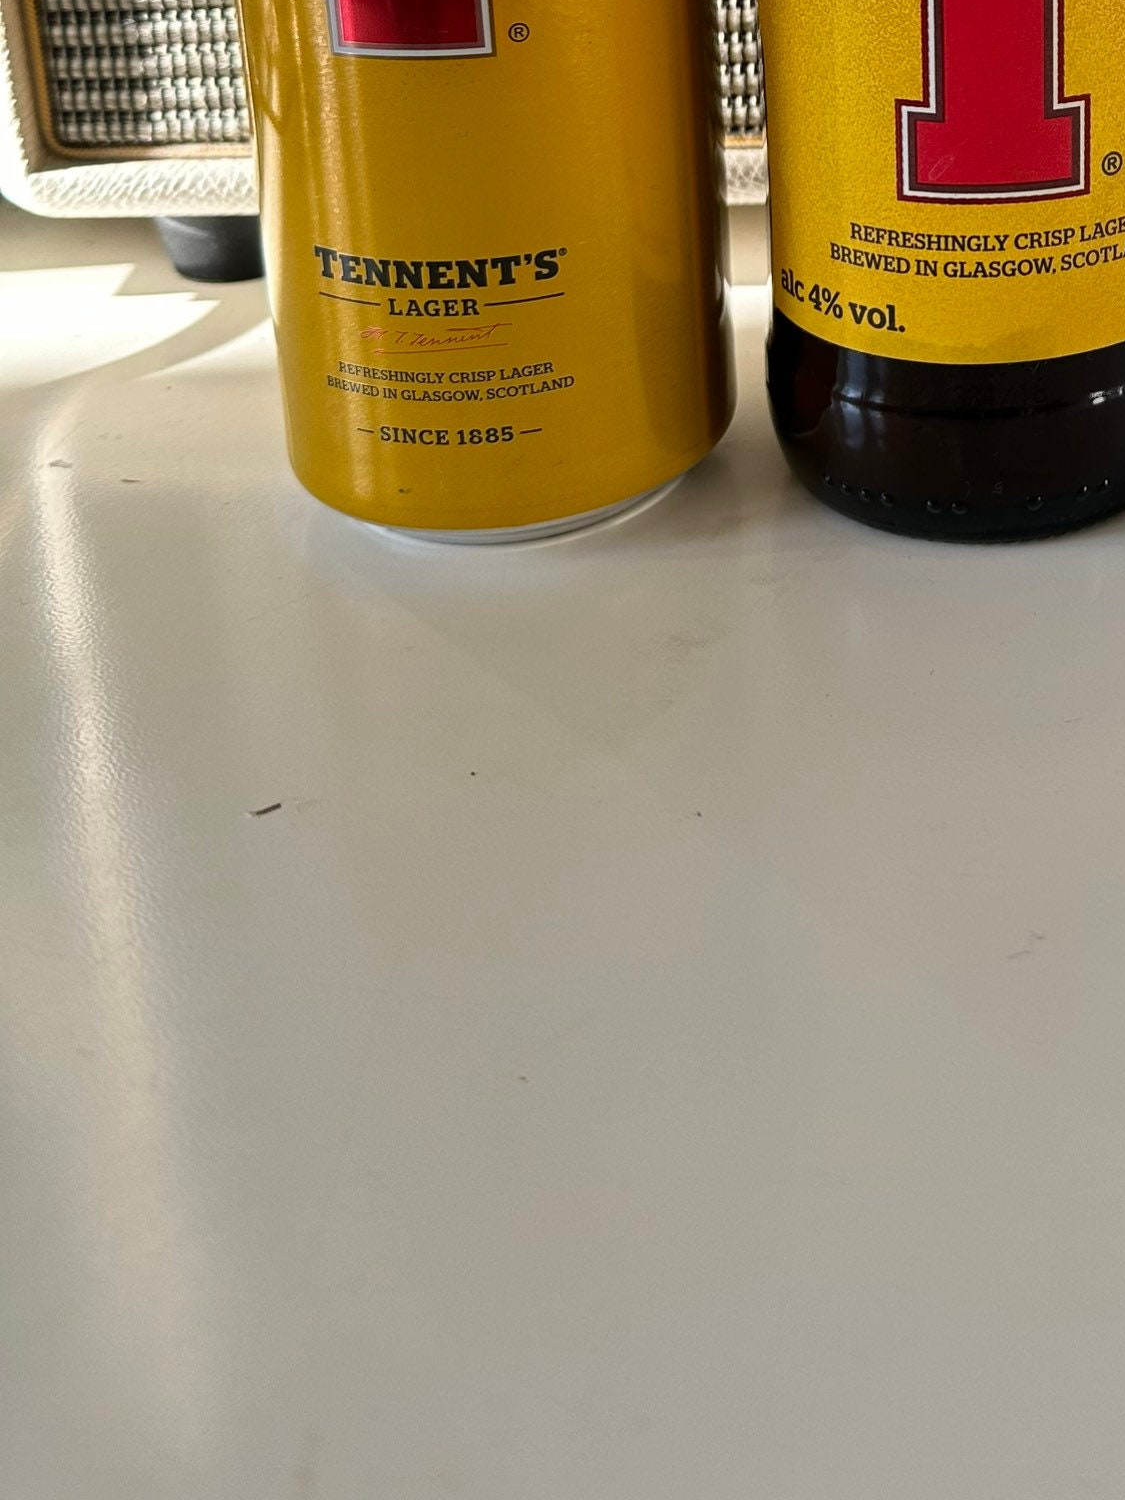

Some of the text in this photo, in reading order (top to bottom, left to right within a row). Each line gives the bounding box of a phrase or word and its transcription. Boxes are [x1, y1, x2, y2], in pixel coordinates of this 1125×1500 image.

[849, 221, 1006, 252] REFRESHINGLY
[1016, 228, 1075, 250] CRISP
[829, 242, 910, 274] BREWED
[914, 257, 938, 276] IN
[942, 259, 1056, 279] GLASGOW,
[388, 297, 480, 317] LAGER
[780, 268, 906, 333] alc 4% vol.
[338, 361, 555, 384] REFRESHINGLY CRISP LAGER
[327, 374, 575, 402] BREWED IN GLASGOW, SCOTLAND
[380, 425, 515, 445] SINCE 1885
